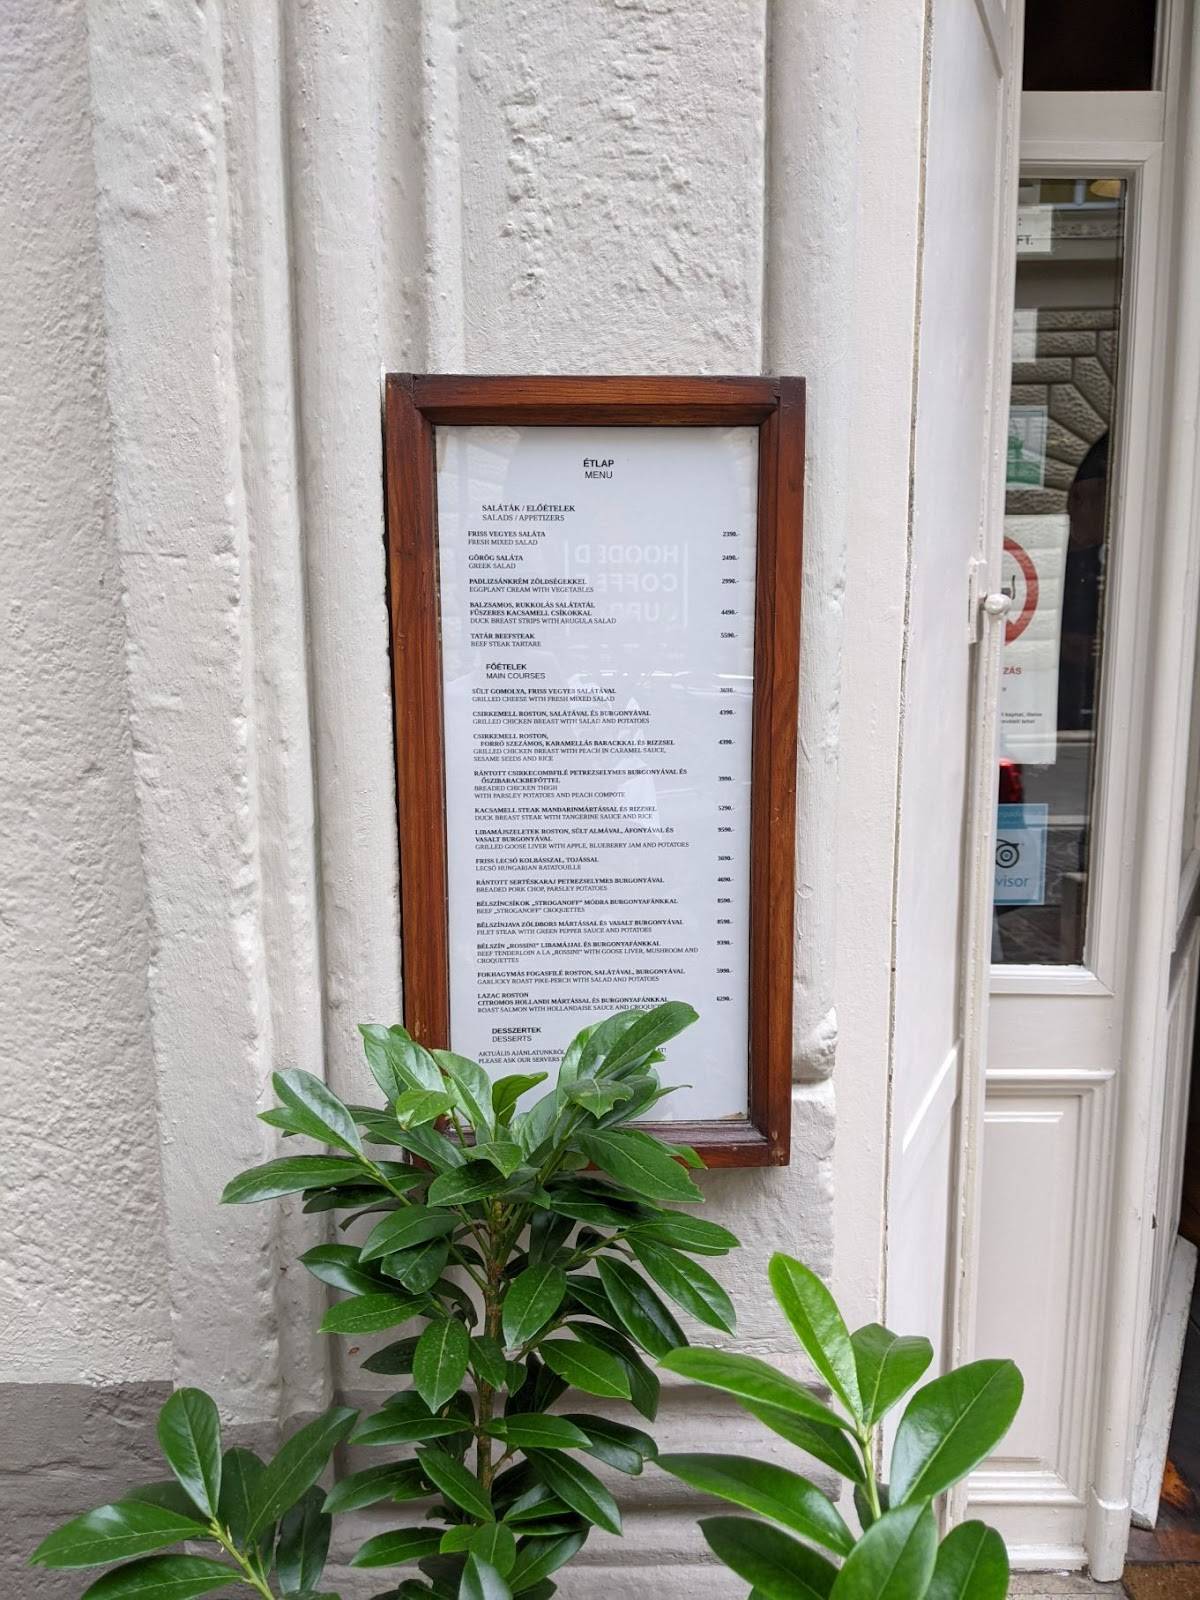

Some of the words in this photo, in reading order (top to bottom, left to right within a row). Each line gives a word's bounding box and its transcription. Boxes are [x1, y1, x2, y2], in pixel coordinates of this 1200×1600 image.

[583, 458, 615, 467] ÉTLAP
[584, 471, 613, 479] MENU
[482, 504, 520, 512] SALÁTÁK
[526, 504, 576, 512] ELŐÉTELEK
[470, 632, 493, 640] TATÁR
[994, 874, 1029, 888] visor
[492, 1035, 532, 1043] DESSERTS
